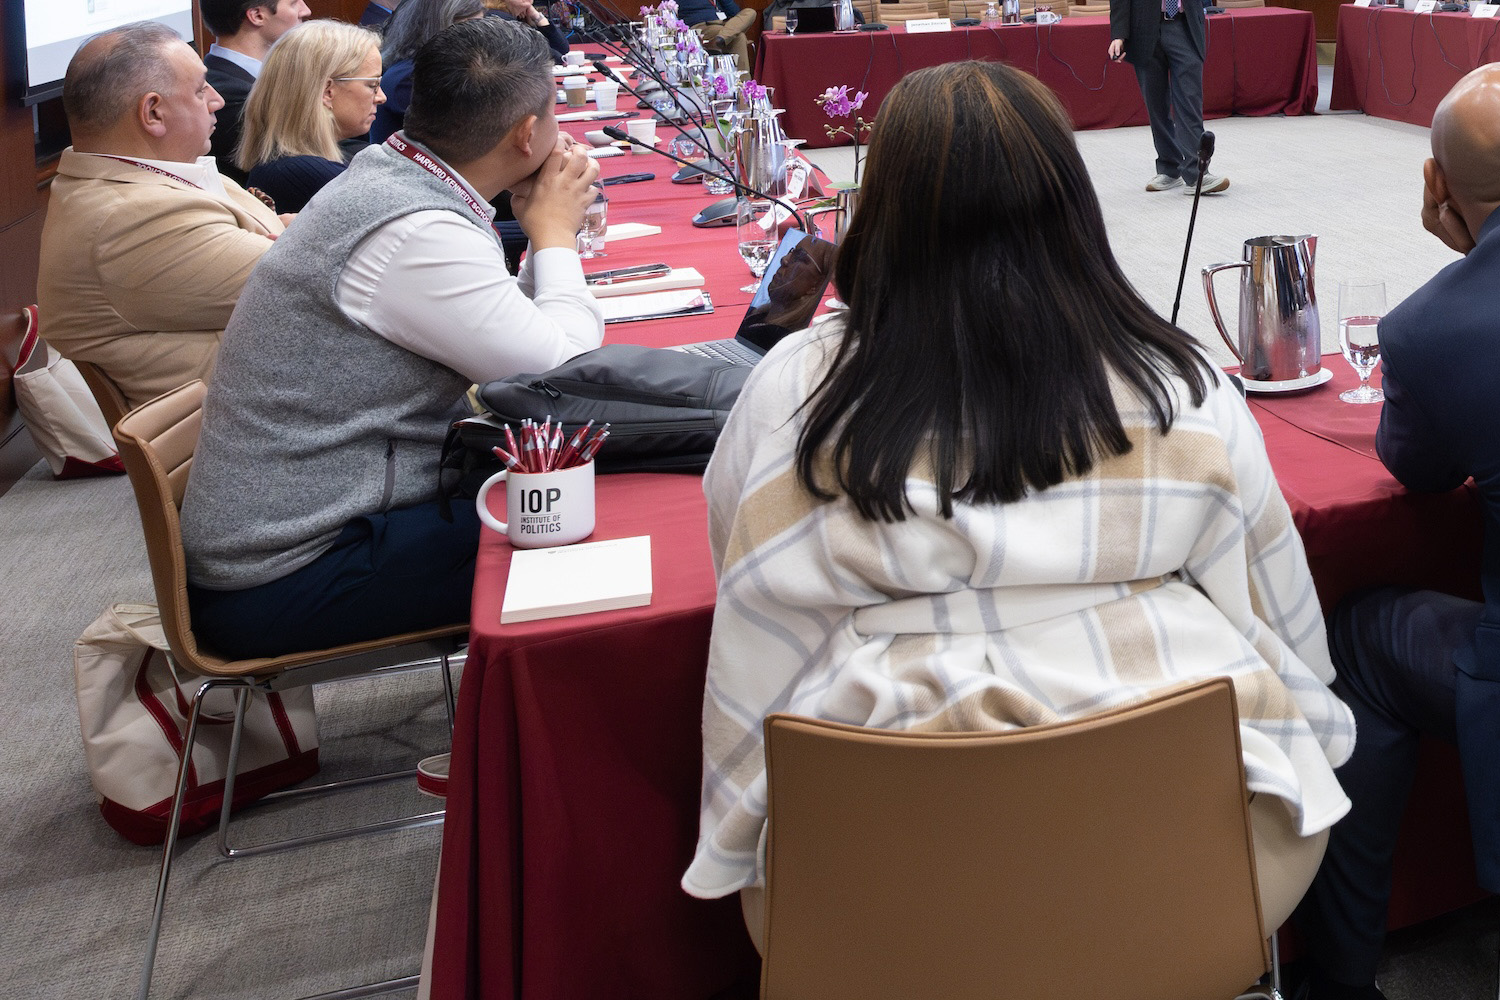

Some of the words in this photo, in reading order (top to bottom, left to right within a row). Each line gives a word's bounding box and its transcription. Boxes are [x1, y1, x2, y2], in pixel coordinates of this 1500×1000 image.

[520, 487, 562, 514] IOP
[520, 515, 551, 524] INSTITUTE
[552, 514, 561, 522] OF
[520, 522, 562, 534] POLITICS
